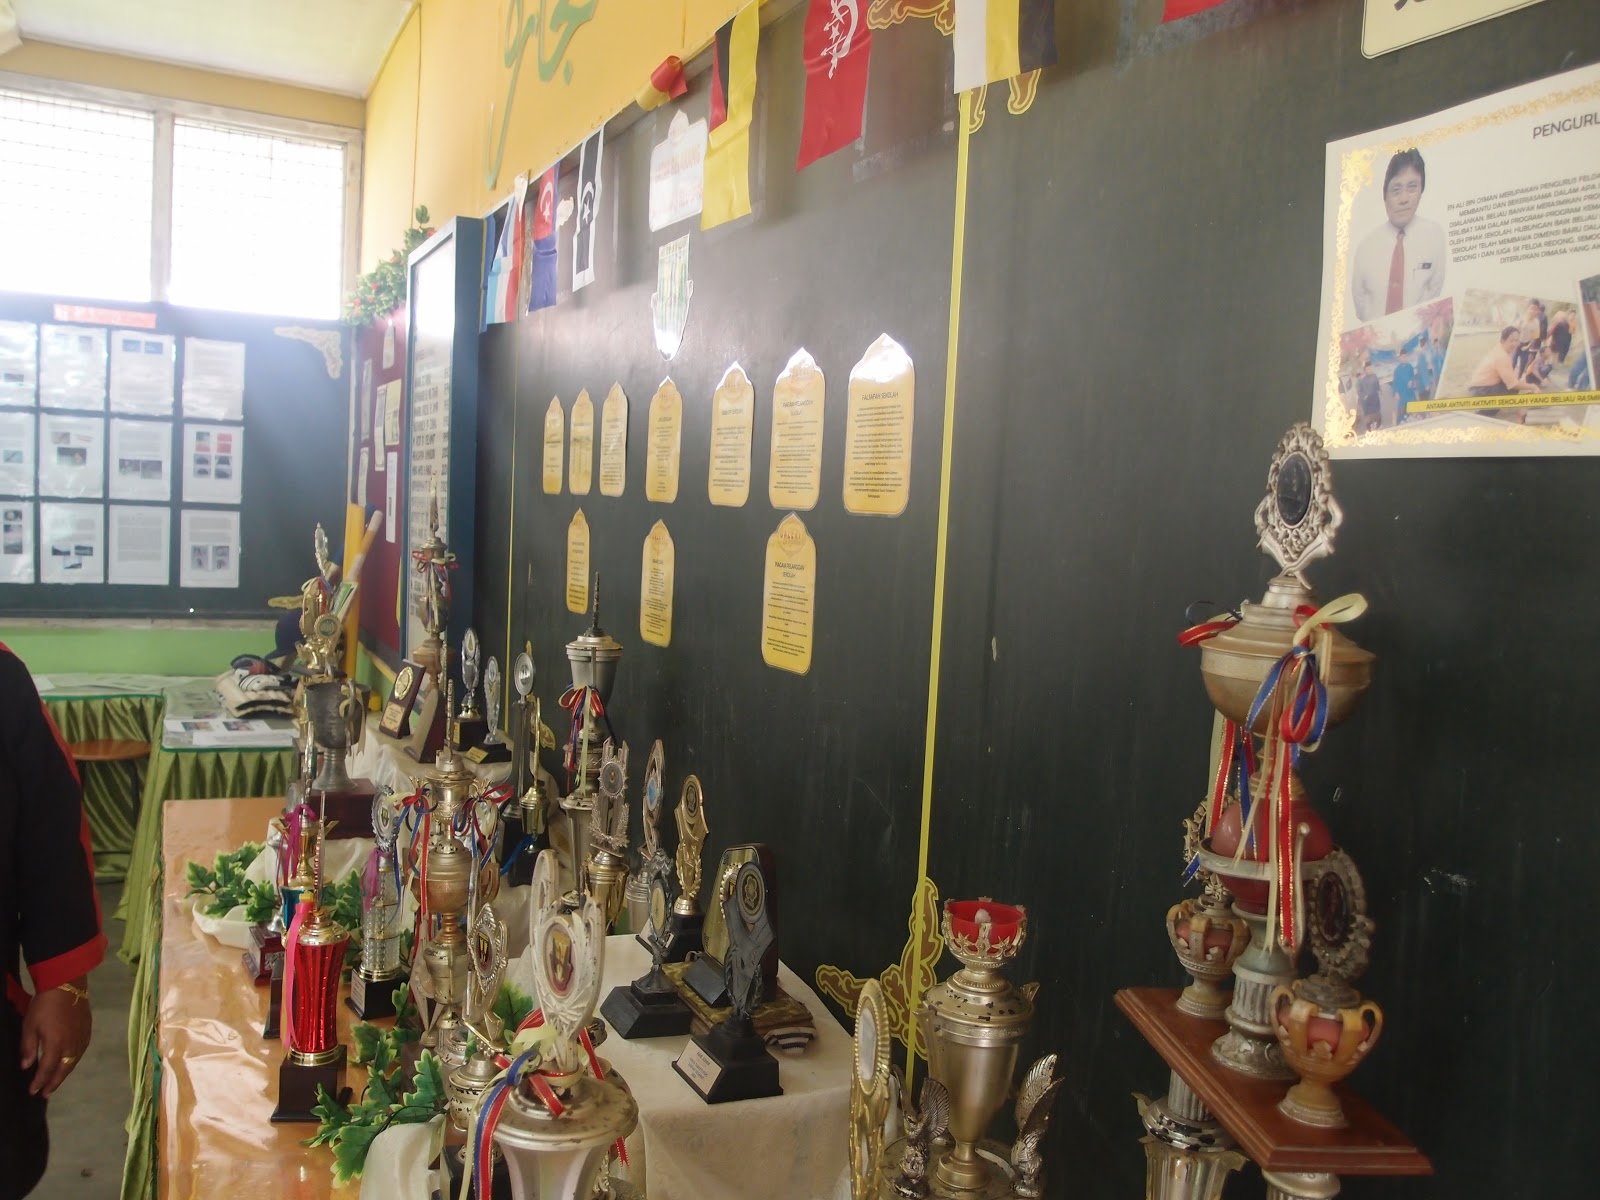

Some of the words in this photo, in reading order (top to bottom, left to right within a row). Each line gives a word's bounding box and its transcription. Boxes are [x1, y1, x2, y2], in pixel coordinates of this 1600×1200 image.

[1466, 199, 1476, 207] BIN
[1477, 194, 1498, 204] OSMAN
[1499, 186, 1539, 199] MERUPAKAN
[1540, 177, 1577, 189] PENGURUS
[1493, 202, 1506, 210] DAN
[1554, 187, 1579, 197] DALAM
[1581, 184, 1596, 192] APA
[1509, 204, 1535, 216] BANYAK
[1536, 197, 1582, 210] MERASMIKAN
[1449, 237, 1464, 246] OLEH
[1465, 234, 1483, 243] PIHAK
[1514, 221, 1553, 233] HUBUNGAN
[1554, 218, 1570, 226] BAIK
[1572, 214, 1597, 223] BELIAU
[1488, 220, 1509, 229] DALAM
[1452, 244, 1477, 254] SEKOLAH
[1478, 241, 1497, 249] TELAH
[1499, 235, 1532, 245] MEMBAWA
[1533, 229, 1561, 239] DIMENSI
[1562, 226, 1582, 234] BARU
[1453, 254, 1477, 263] REDONG
[1481, 250, 1495, 258] DAN
[1521, 242, 1542, 251] FELDA
[1500, 253, 1539, 264] DITERUSKAN
[1541, 248, 1567, 258] DIMASA
